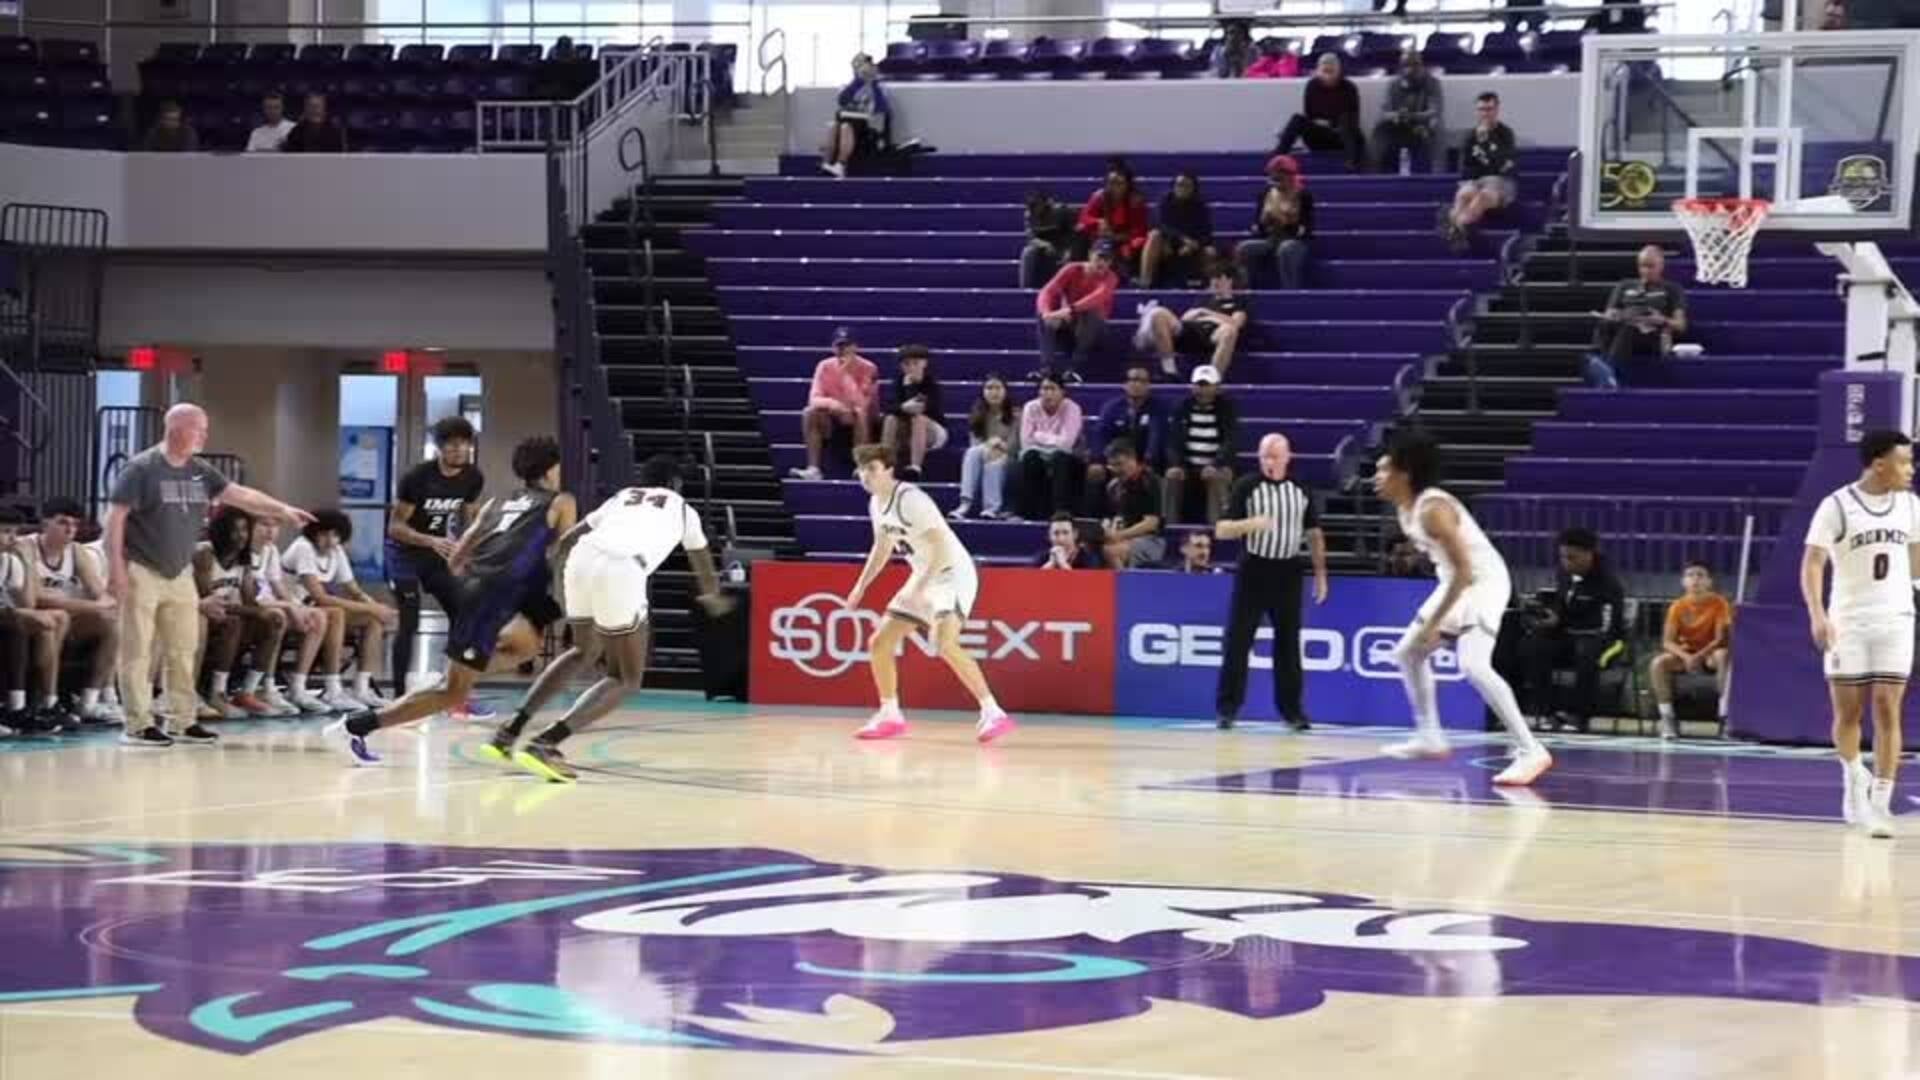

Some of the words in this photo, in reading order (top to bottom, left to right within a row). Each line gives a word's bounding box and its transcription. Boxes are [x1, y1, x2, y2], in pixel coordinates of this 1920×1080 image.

[624, 489, 668, 509] 34
[1850, 528, 1907, 549] IRONME
[1874, 553, 1889, 580] 0
[1129, 622, 1345, 672] GECO
